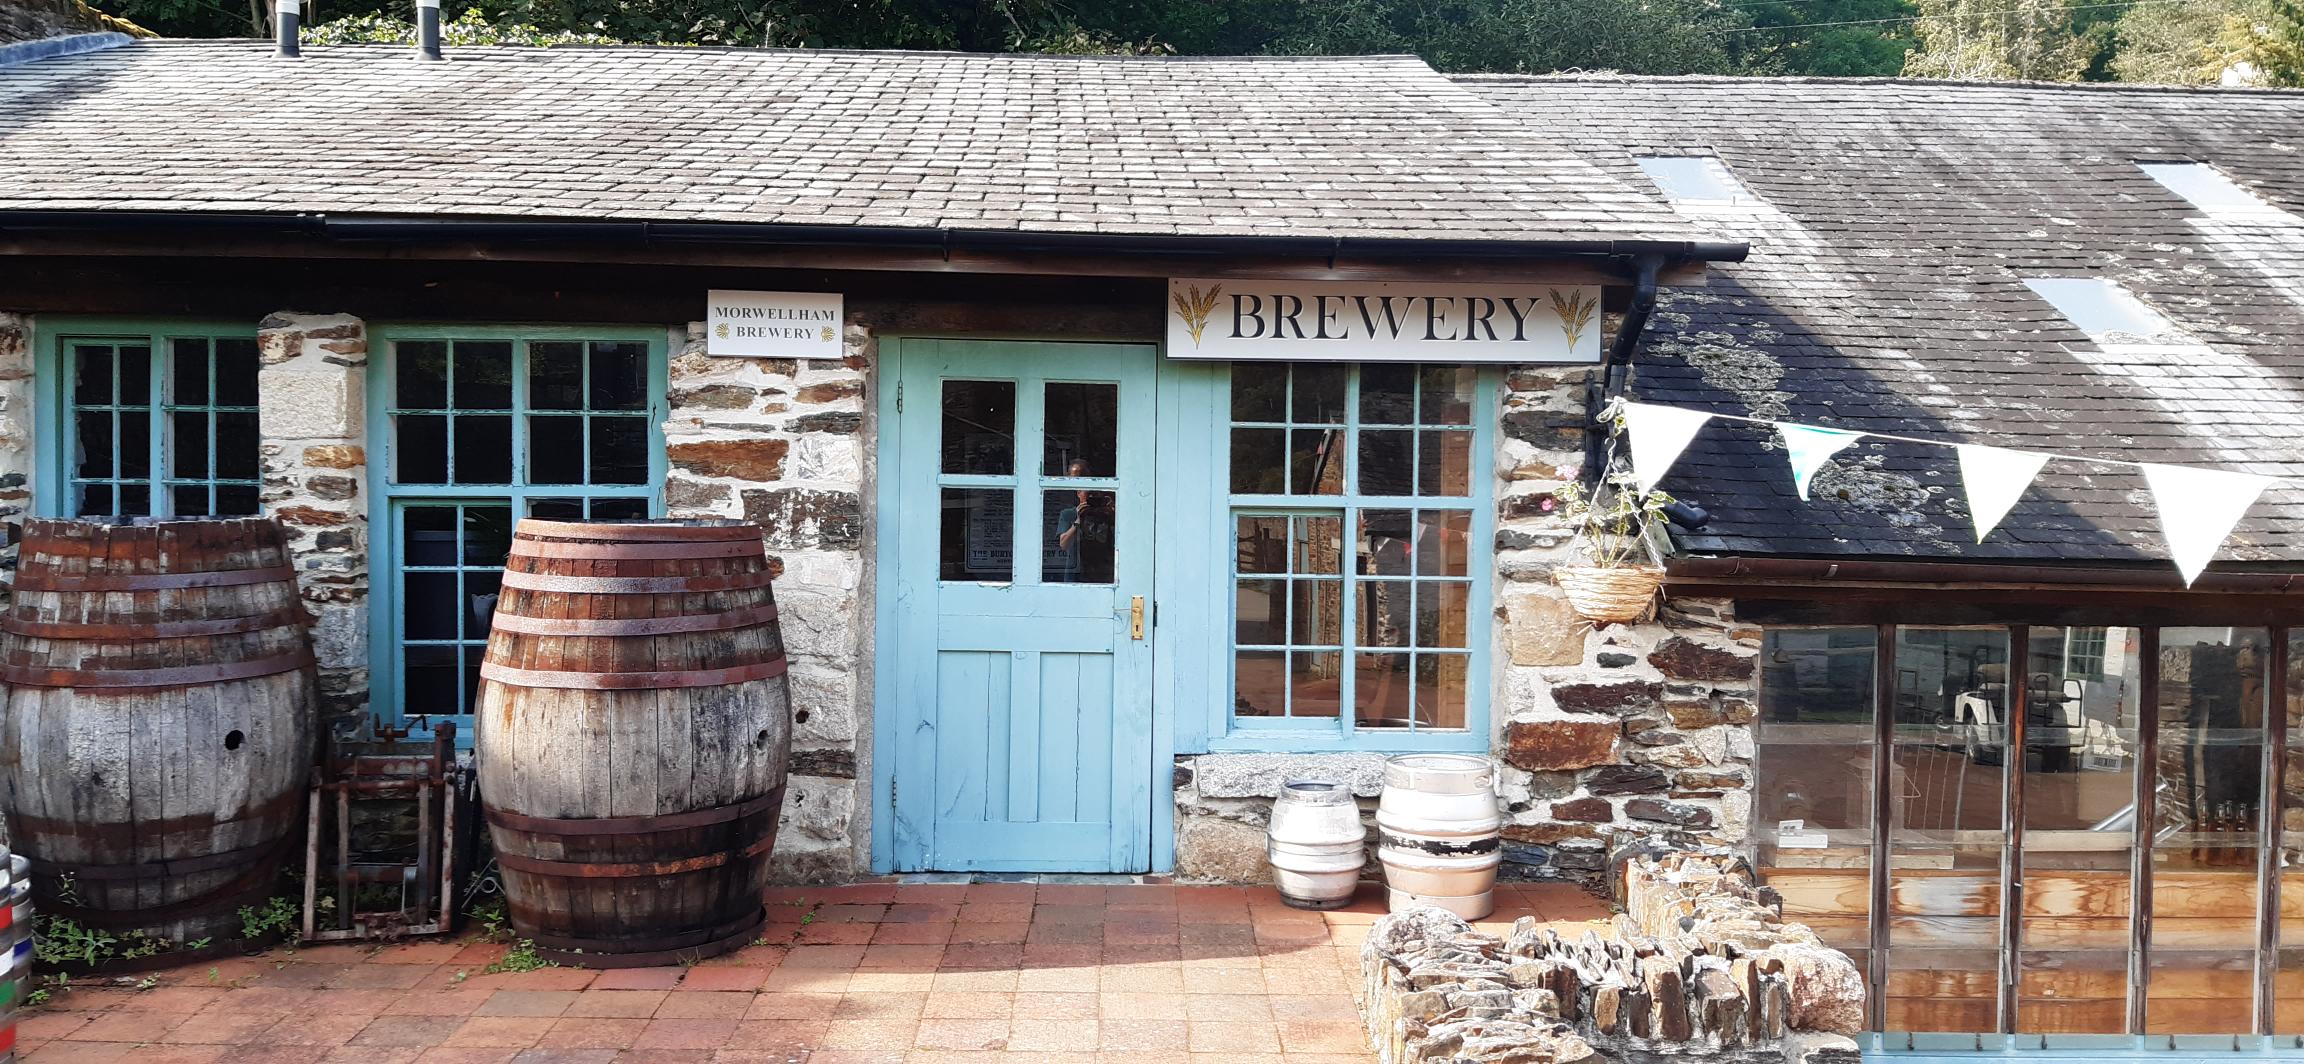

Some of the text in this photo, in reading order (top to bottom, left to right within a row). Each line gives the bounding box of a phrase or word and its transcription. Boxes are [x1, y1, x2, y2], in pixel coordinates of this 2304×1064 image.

[715, 306, 835, 321] MORWELLHAM
[1228, 294, 1540, 341] BREWERY
[736, 326, 814, 339] BREWERY
